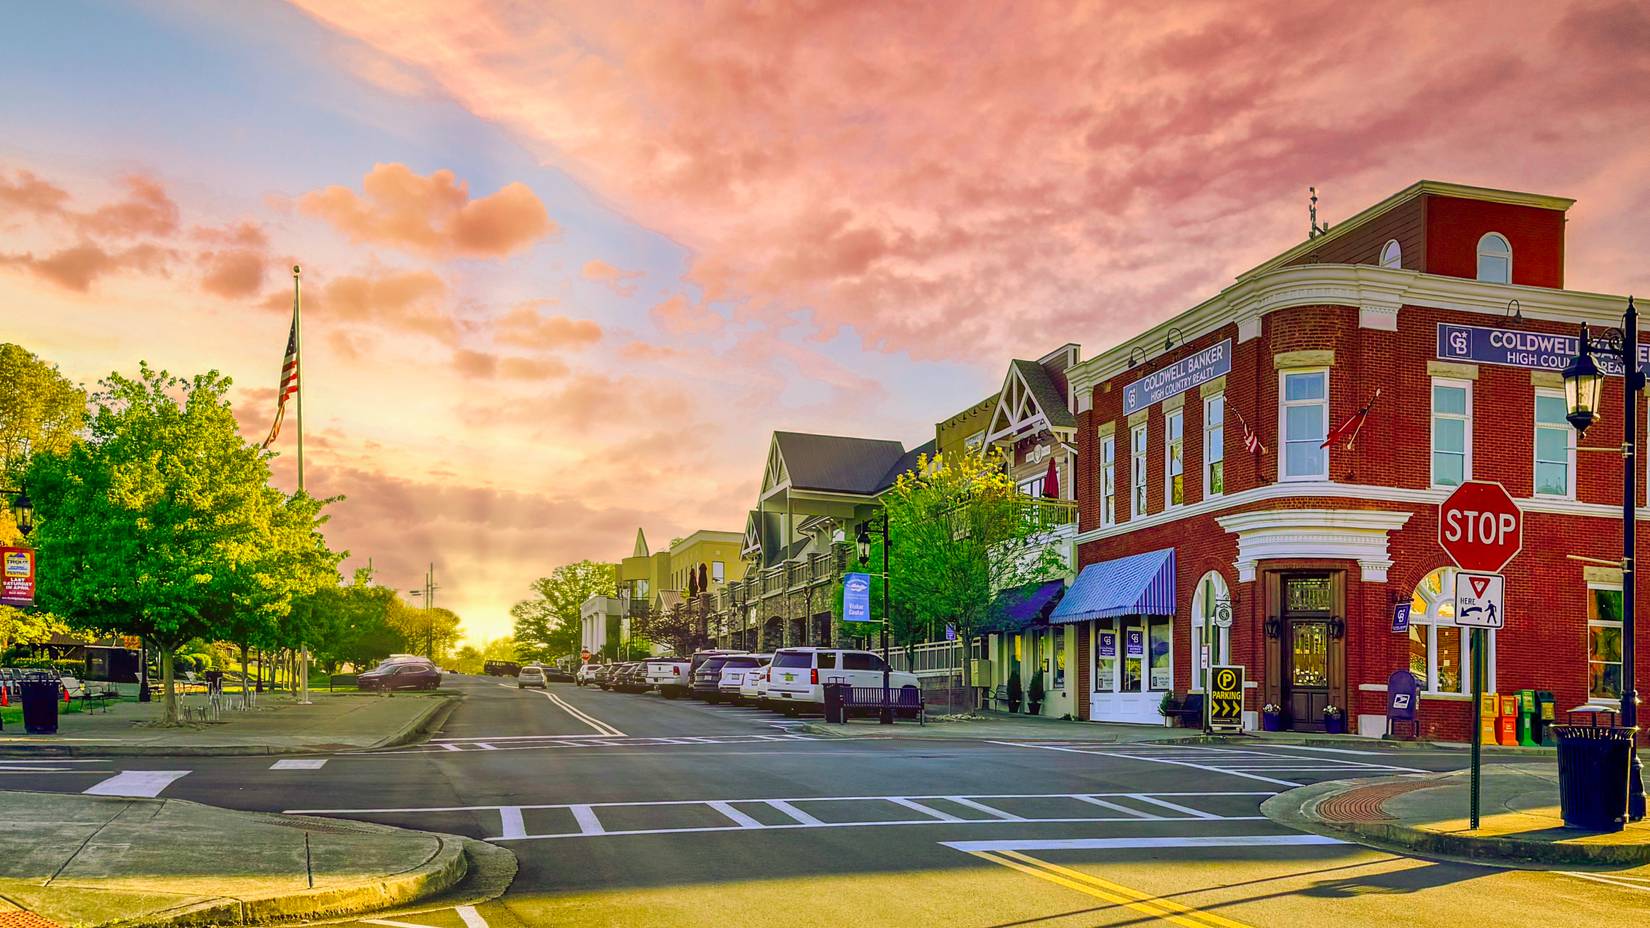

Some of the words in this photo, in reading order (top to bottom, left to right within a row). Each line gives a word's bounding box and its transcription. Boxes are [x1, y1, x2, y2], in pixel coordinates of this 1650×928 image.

[1490, 331, 1580, 356] COLDWELL
[1507, 352, 1538, 365] HIGH
[1144, 362, 1186, 392] COLDWELL
[1188, 345, 1223, 373] BANKER
[1151, 387, 1165, 402] HIGH
[1165, 376, 1192, 396] COUNTRY
[1193, 365, 1215, 384] REALTY
[1445, 508, 1517, 545] STOP
[1460, 597, 1476, 606] HERE
[1222, 673, 1232, 687] P
[1212, 691, 1241, 700] PARKING
